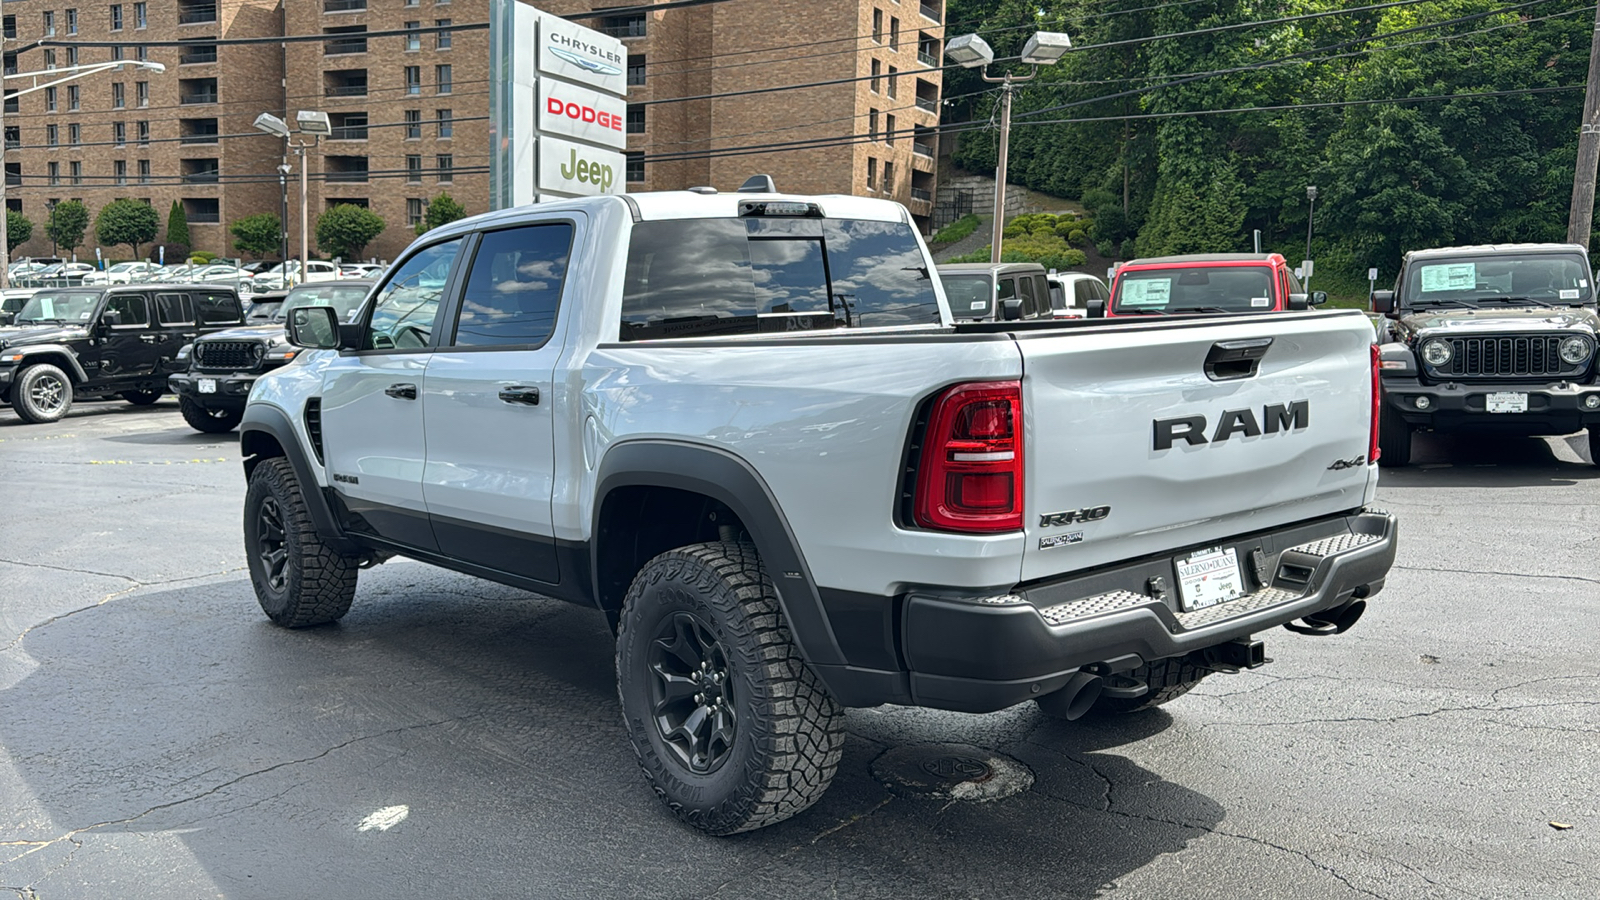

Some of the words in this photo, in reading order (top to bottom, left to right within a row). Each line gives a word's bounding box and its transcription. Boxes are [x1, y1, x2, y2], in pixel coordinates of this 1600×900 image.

[550, 33, 621, 64] CHRYSLER
[547, 97, 622, 131] DODGE
[560, 148, 613, 193] Jeep
[1153, 399, 1309, 451] RAM
[1326, 454, 1365, 471] 4x4
[1039, 504, 1112, 528] RHO
[1180, 562, 1210, 577] SALERNO
[1212, 555, 1236, 569] DUANE
[1218, 581, 1233, 591] Jeep
